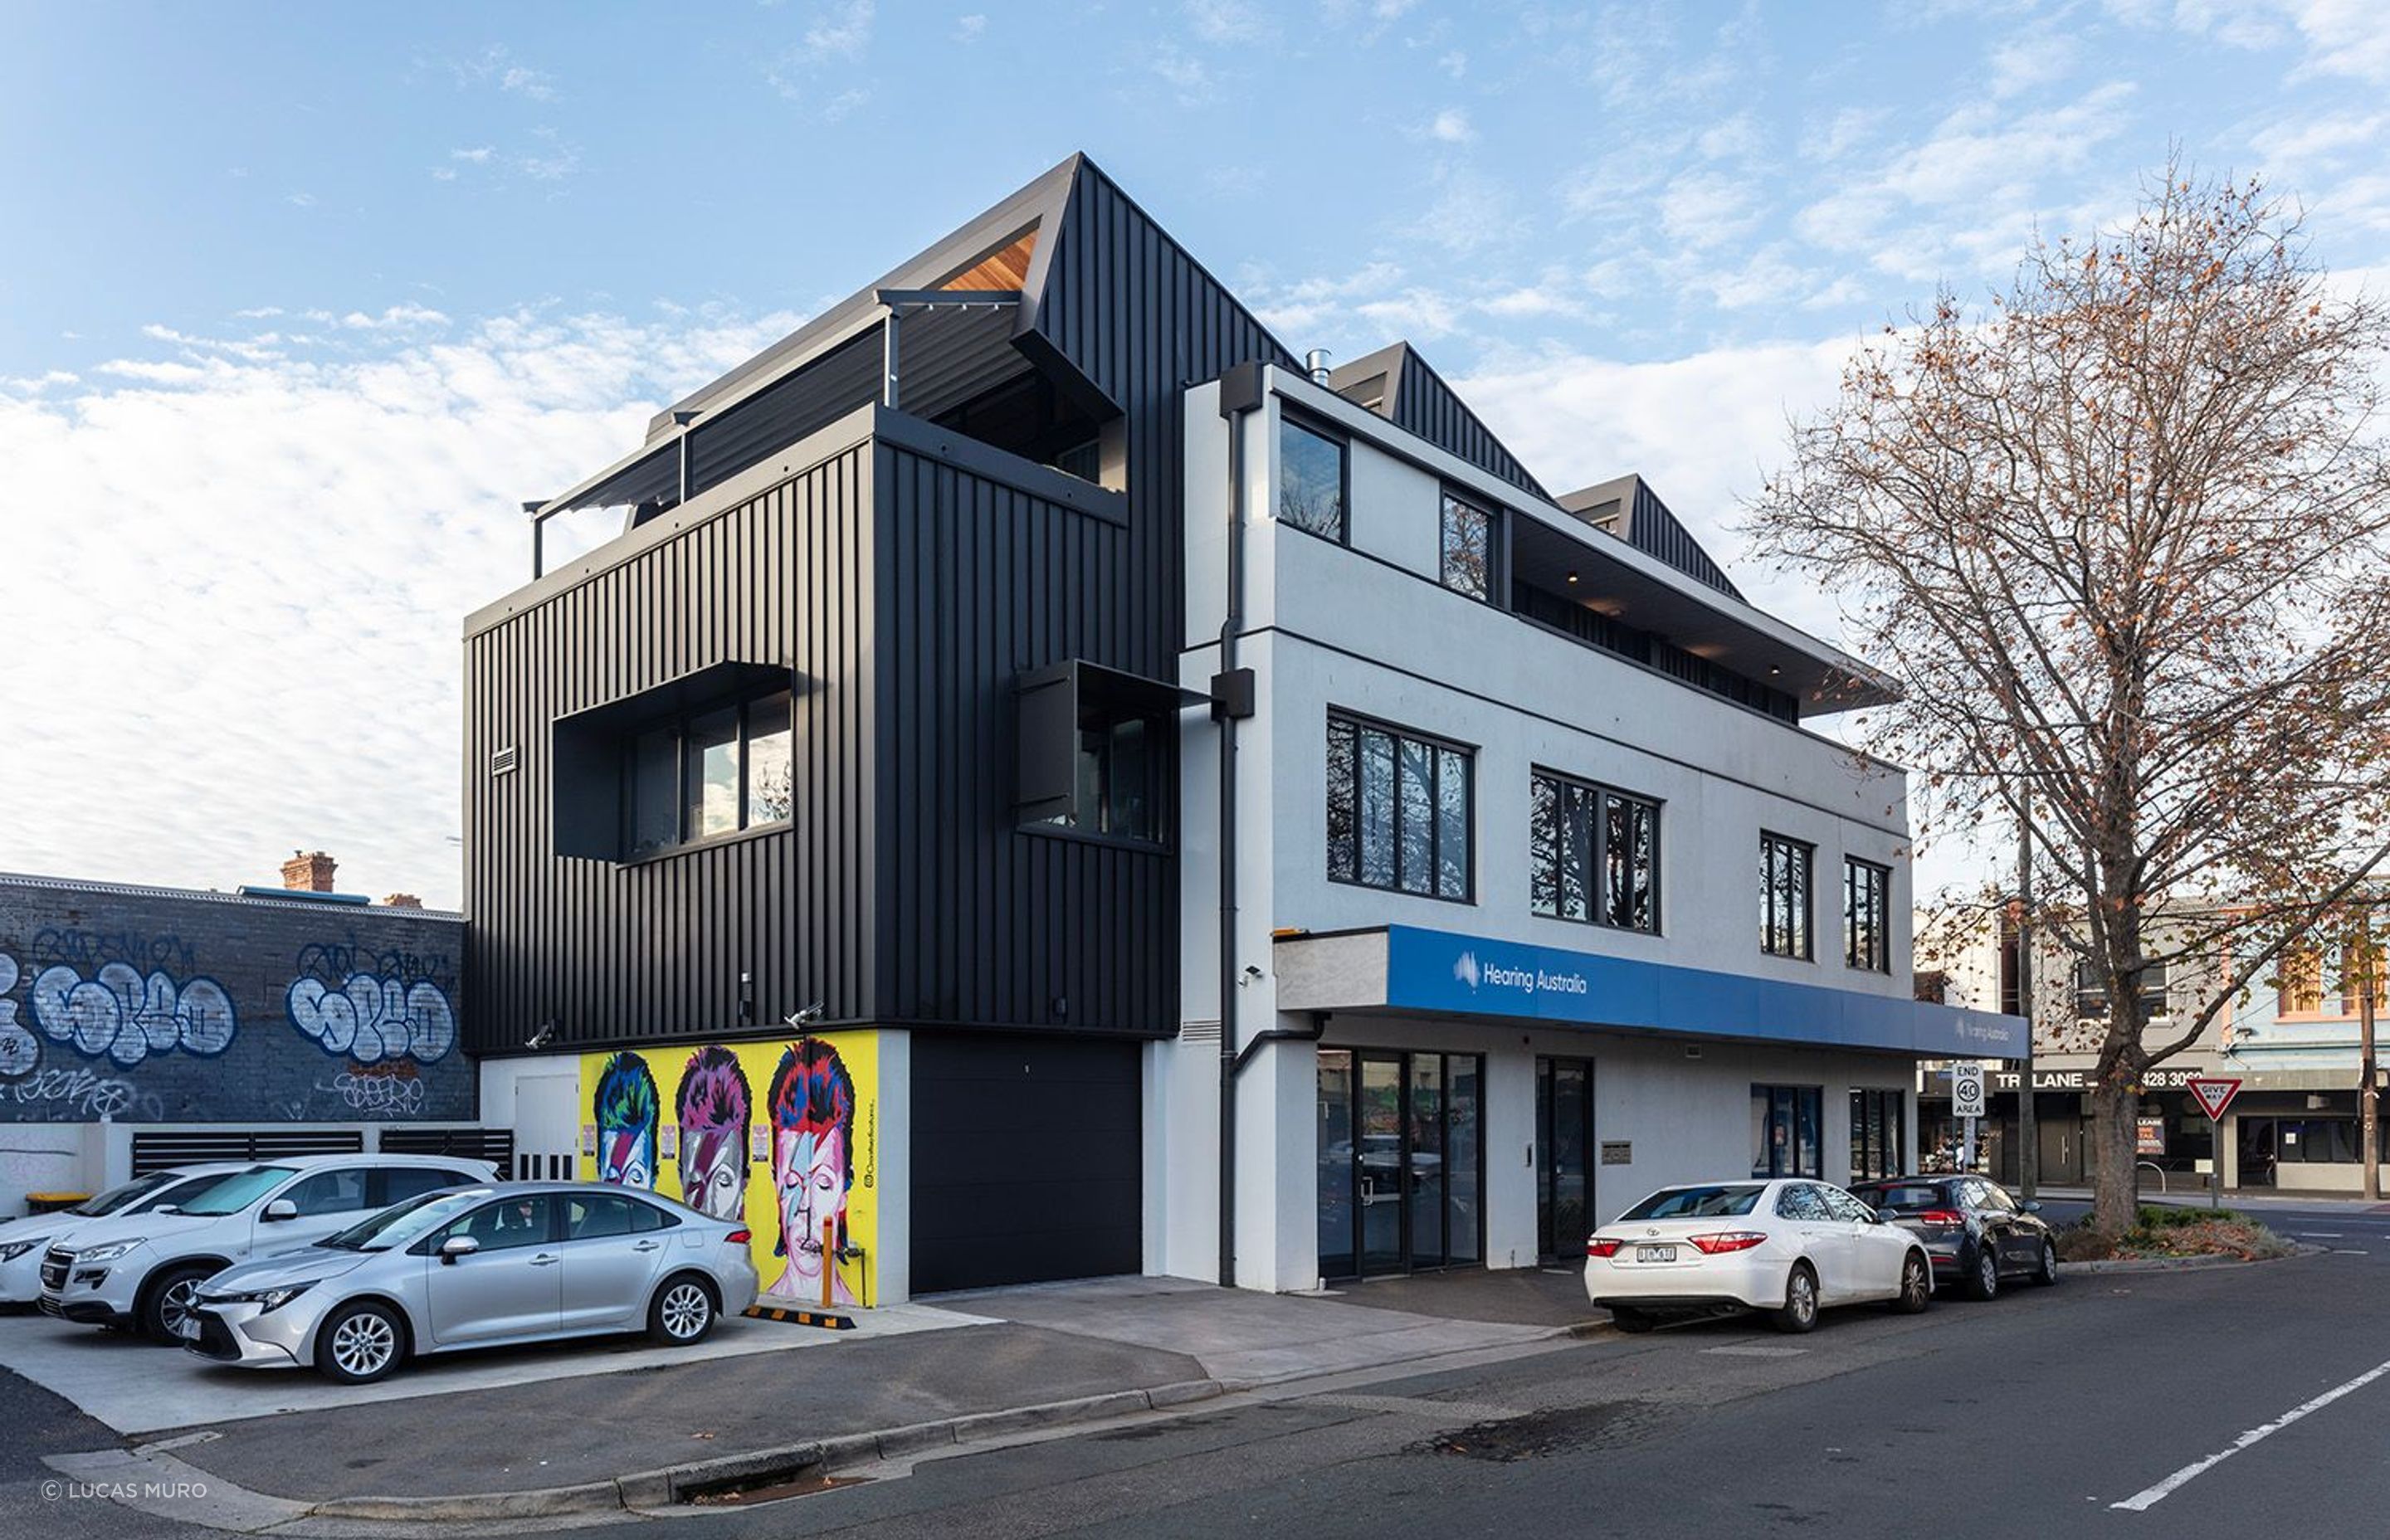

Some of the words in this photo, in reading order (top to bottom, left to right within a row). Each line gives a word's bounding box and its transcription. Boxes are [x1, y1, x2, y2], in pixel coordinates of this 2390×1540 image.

[1484, 962, 1534, 993] Hearing
[1536, 968, 1587, 994] Australia
[1957, 1067, 1978, 1076] END
[1959, 1084, 1978, 1098] 40
[2202, 1085, 2227, 1094] GIVE
[1956, 1105, 1982, 1114] AREA
